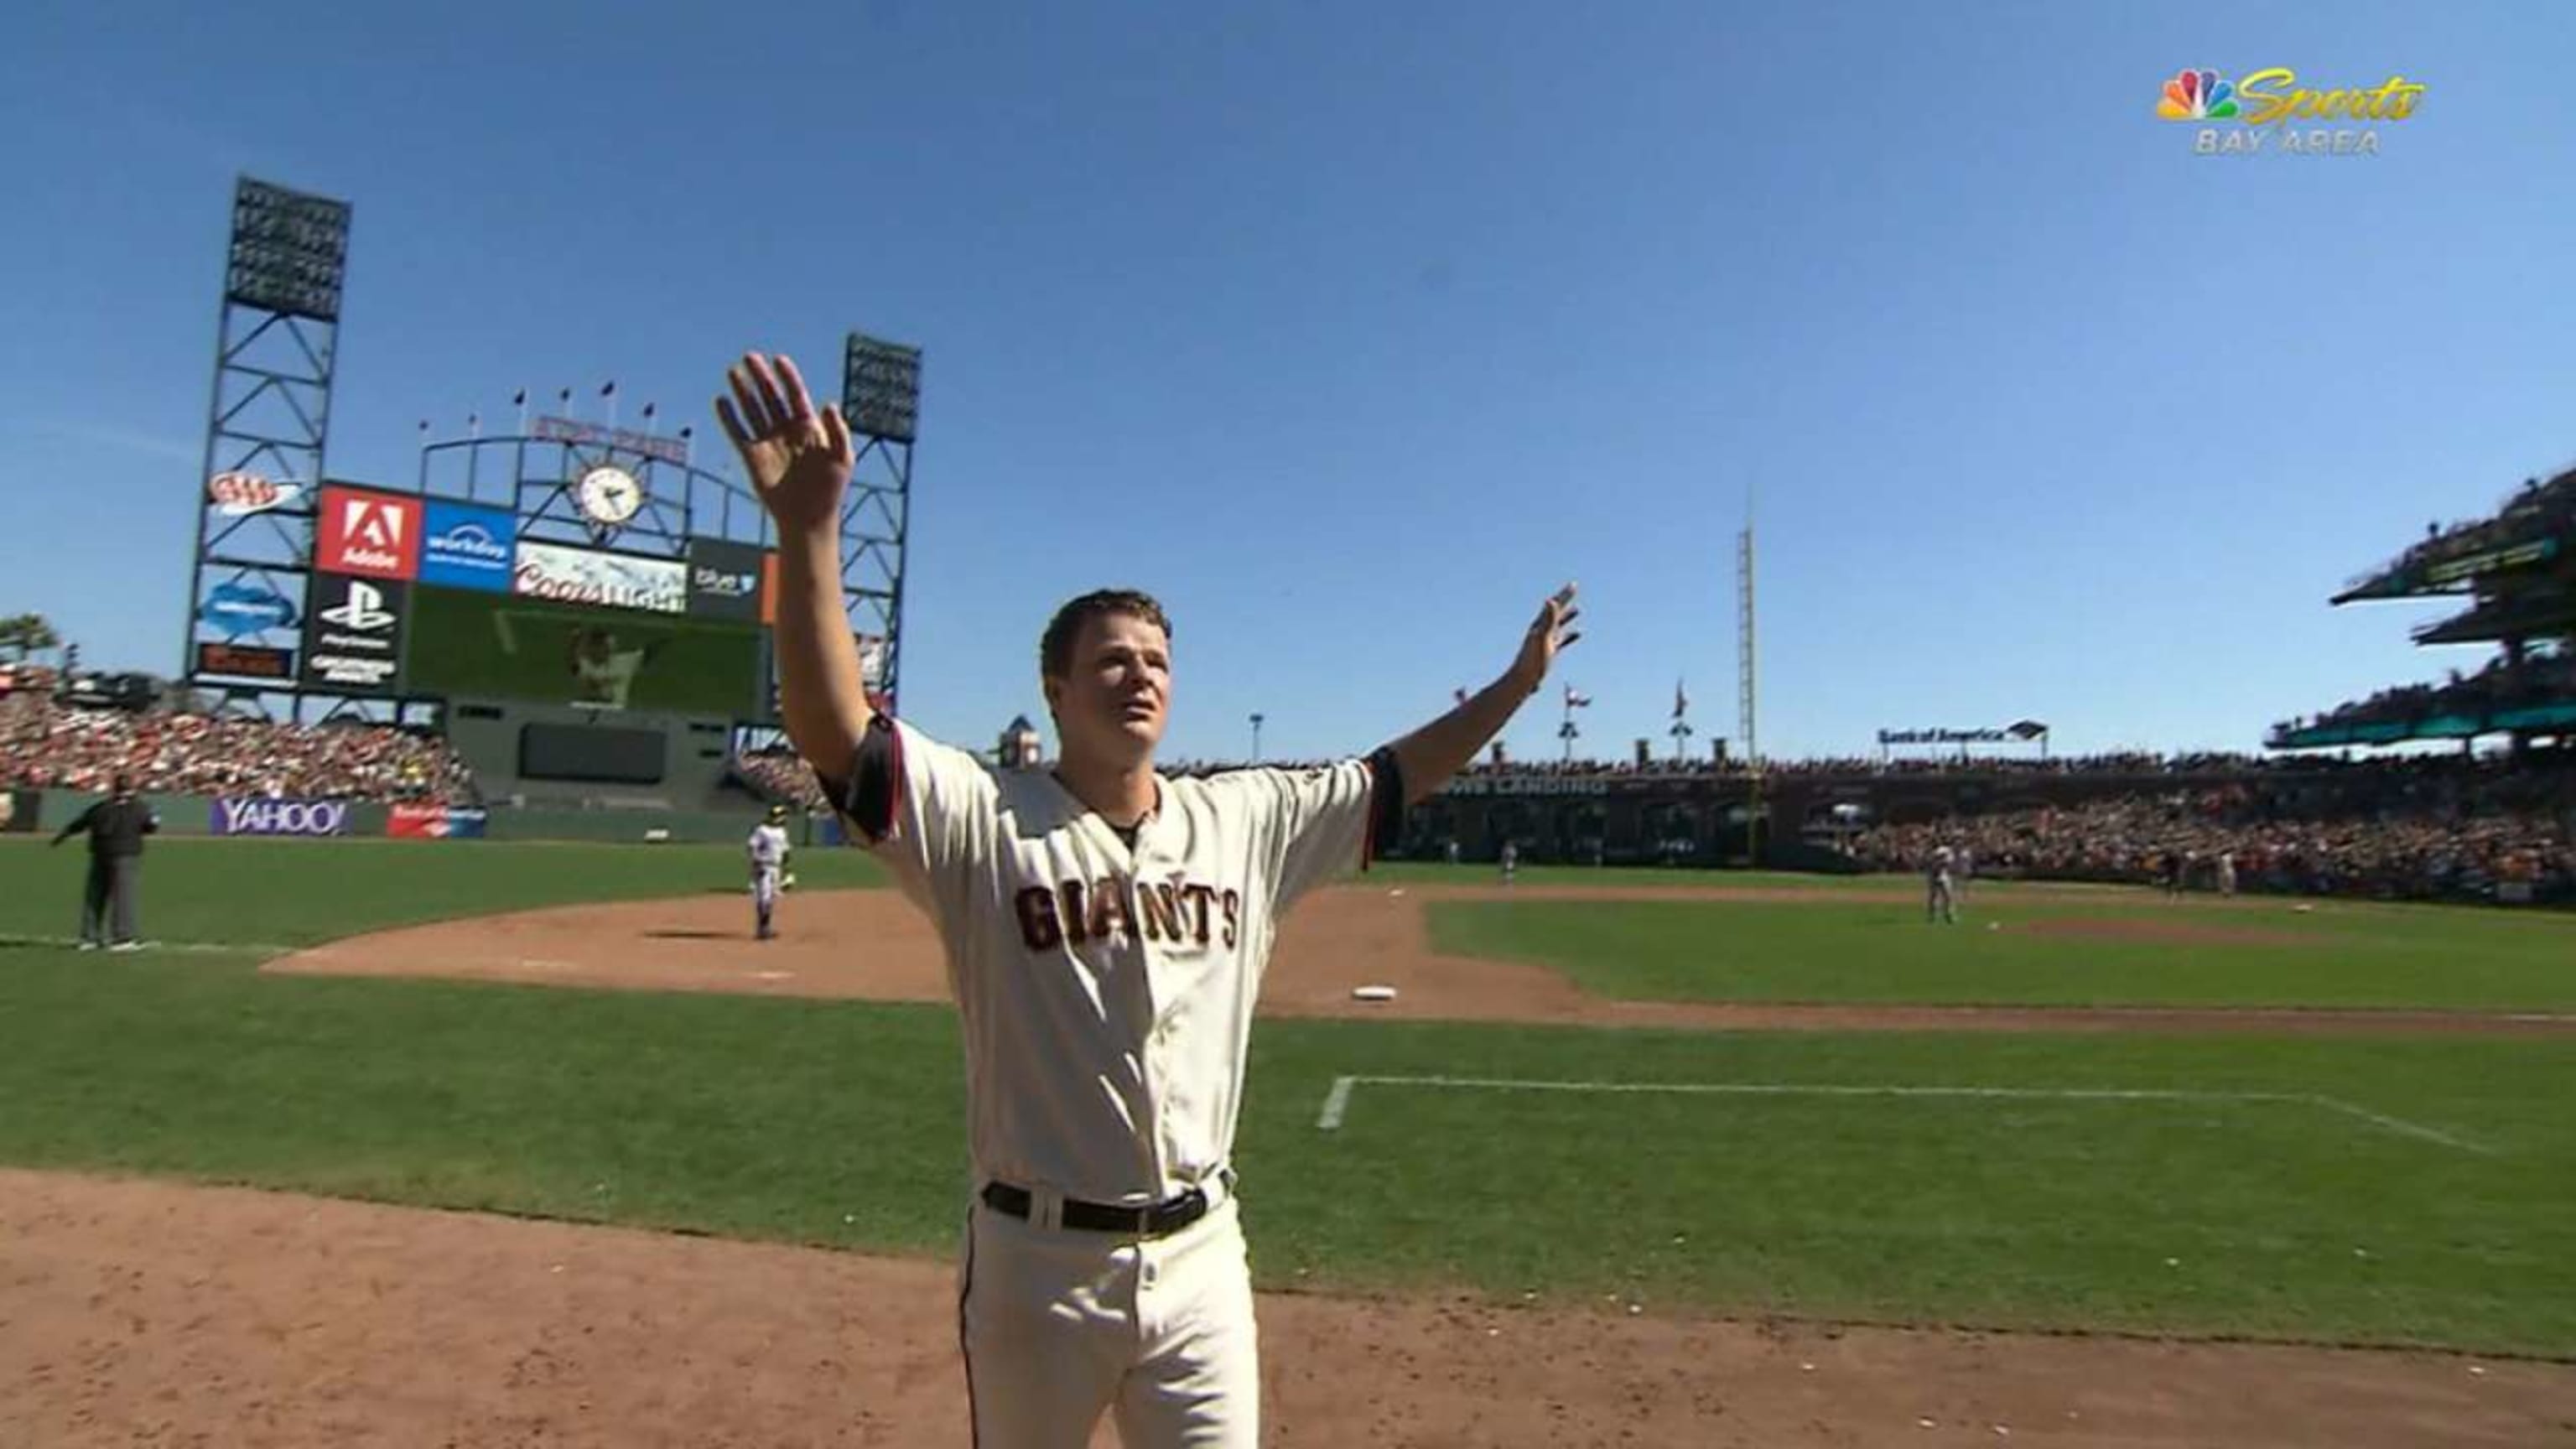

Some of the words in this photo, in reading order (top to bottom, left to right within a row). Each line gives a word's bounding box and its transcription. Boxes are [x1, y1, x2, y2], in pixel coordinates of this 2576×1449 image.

[341, 547, 399, 570] Adobe
[221, 798, 346, 835] YAHOO!
[1015, 877, 1239, 952] GIANTS
